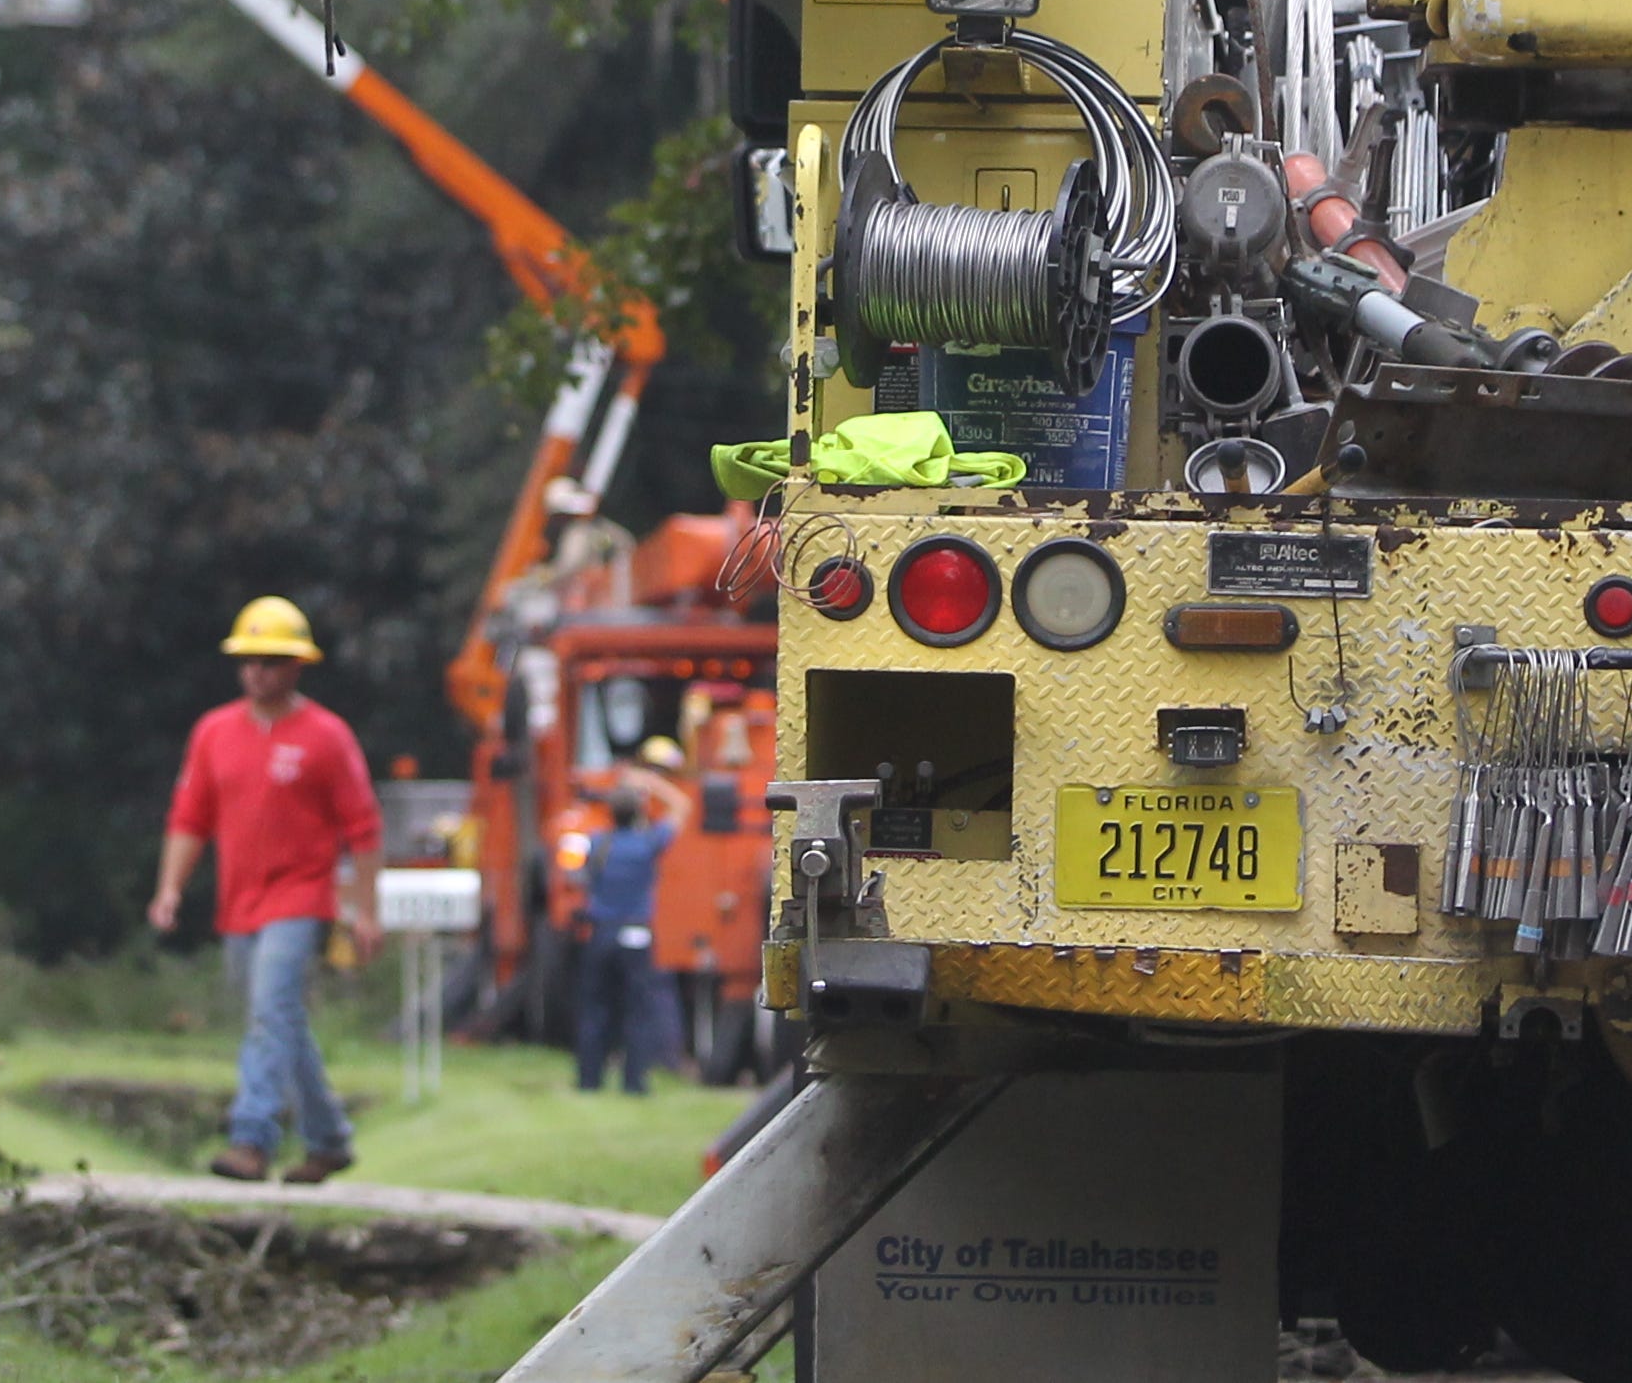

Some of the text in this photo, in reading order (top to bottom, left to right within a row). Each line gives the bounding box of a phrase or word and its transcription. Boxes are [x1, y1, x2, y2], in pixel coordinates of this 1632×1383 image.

[968, 373, 1066, 398] Grayba
[1277, 545, 1319, 561] Altec
[1124, 795, 1234, 811] FLORIDA
[1099, 821, 1259, 881] 212748
[1153, 886, 1203, 900] CITY
[876, 1236, 1219, 1273] City of Tallahassee
[876, 1279, 1216, 1307] Your Own Utilities
